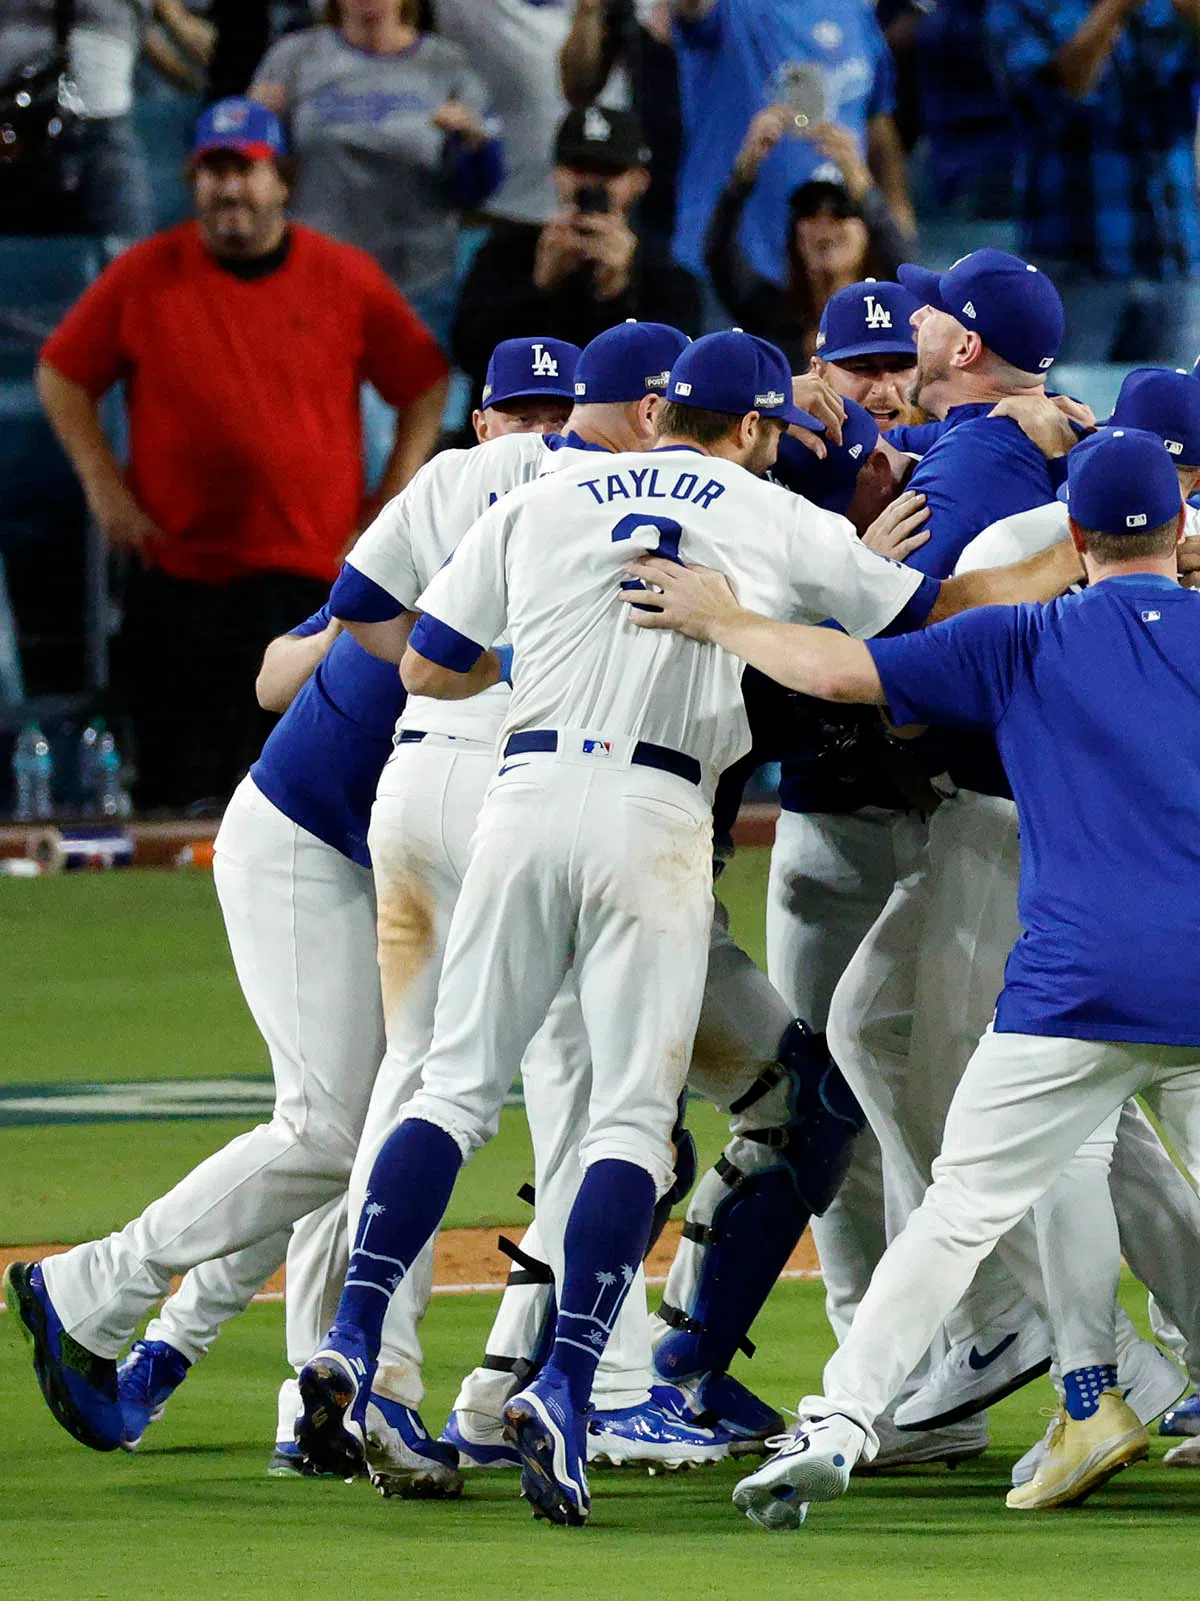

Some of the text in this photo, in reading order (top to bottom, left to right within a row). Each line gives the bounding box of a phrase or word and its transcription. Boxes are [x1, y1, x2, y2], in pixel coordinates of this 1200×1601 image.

[862, 295, 893, 329] LA
[530, 343, 559, 377] LA
[577, 468, 726, 509] TAYLOR
